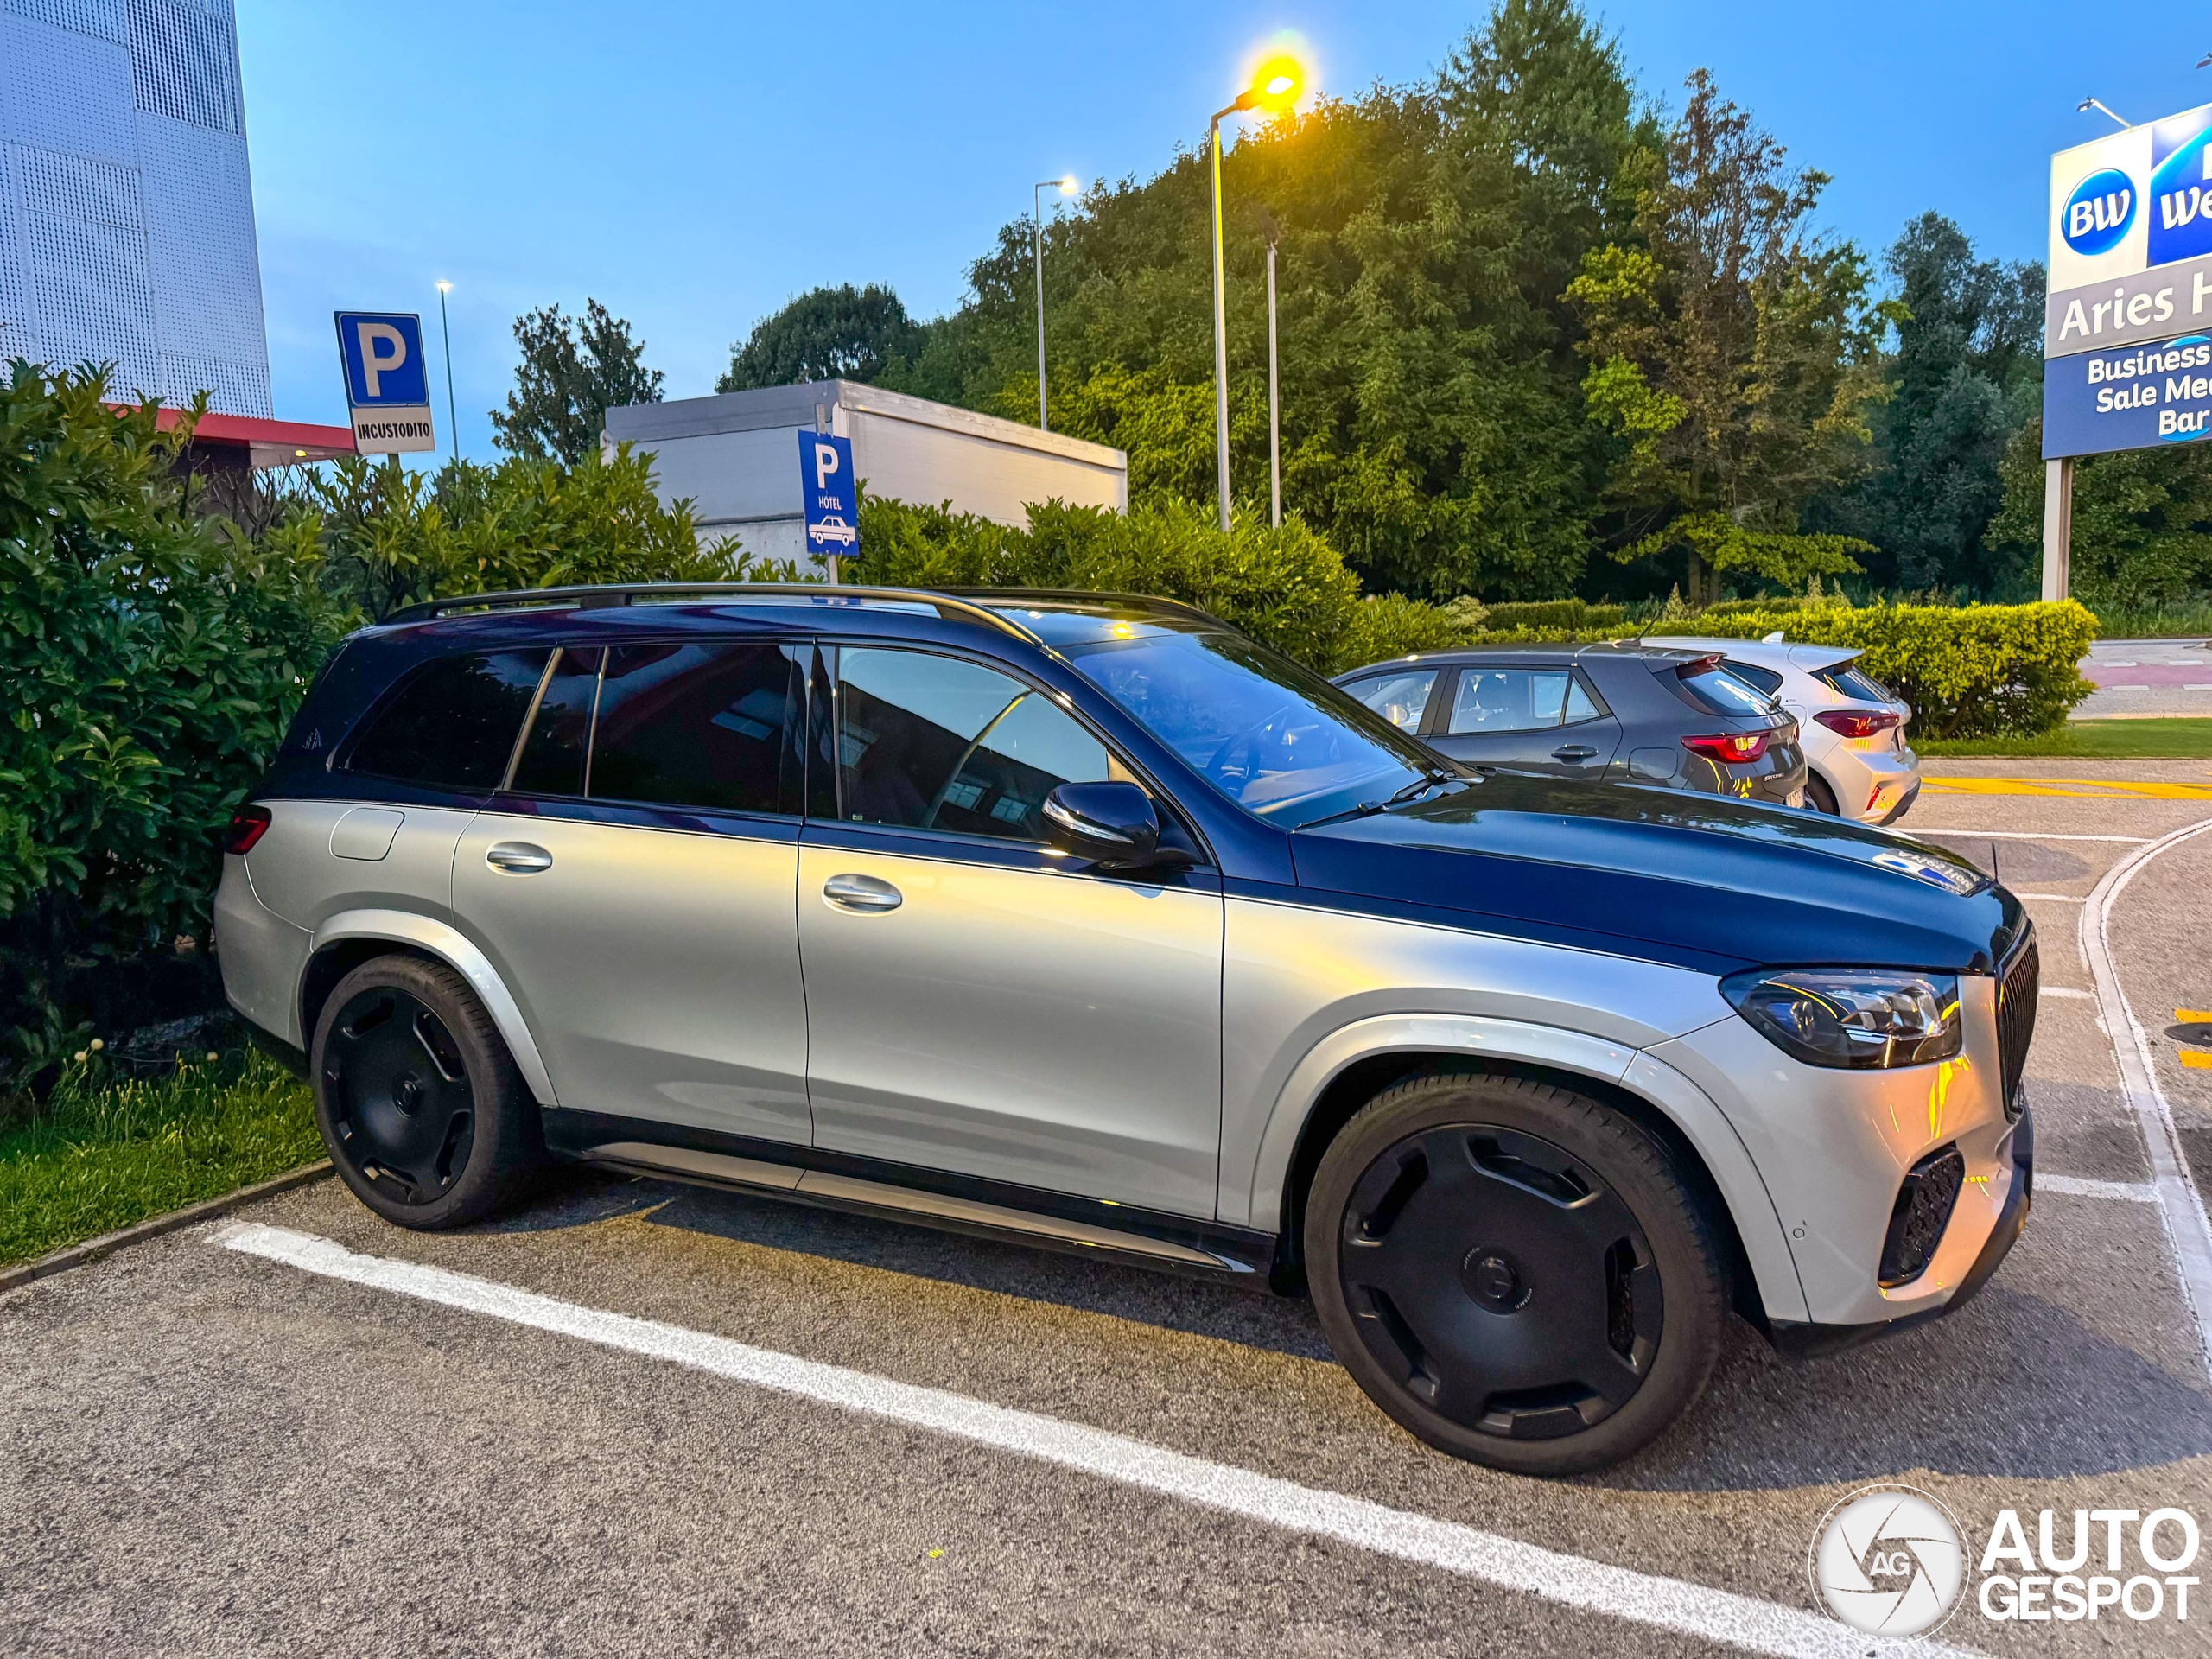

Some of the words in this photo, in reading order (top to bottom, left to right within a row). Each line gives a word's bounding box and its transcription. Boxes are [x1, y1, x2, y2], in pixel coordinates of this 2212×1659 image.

[2069, 188, 2130, 238] BW
[2058, 285, 2174, 341] Aries
[357, 322, 407, 397] P
[2088, 345, 2210, 385] Business
[2096, 385, 2158, 414] Sale
[2164, 375, 2212, 404] Me
[357, 423, 430, 440] INCUSTODITO
[2158, 409, 2210, 435] Bar
[815, 442, 839, 489] P
